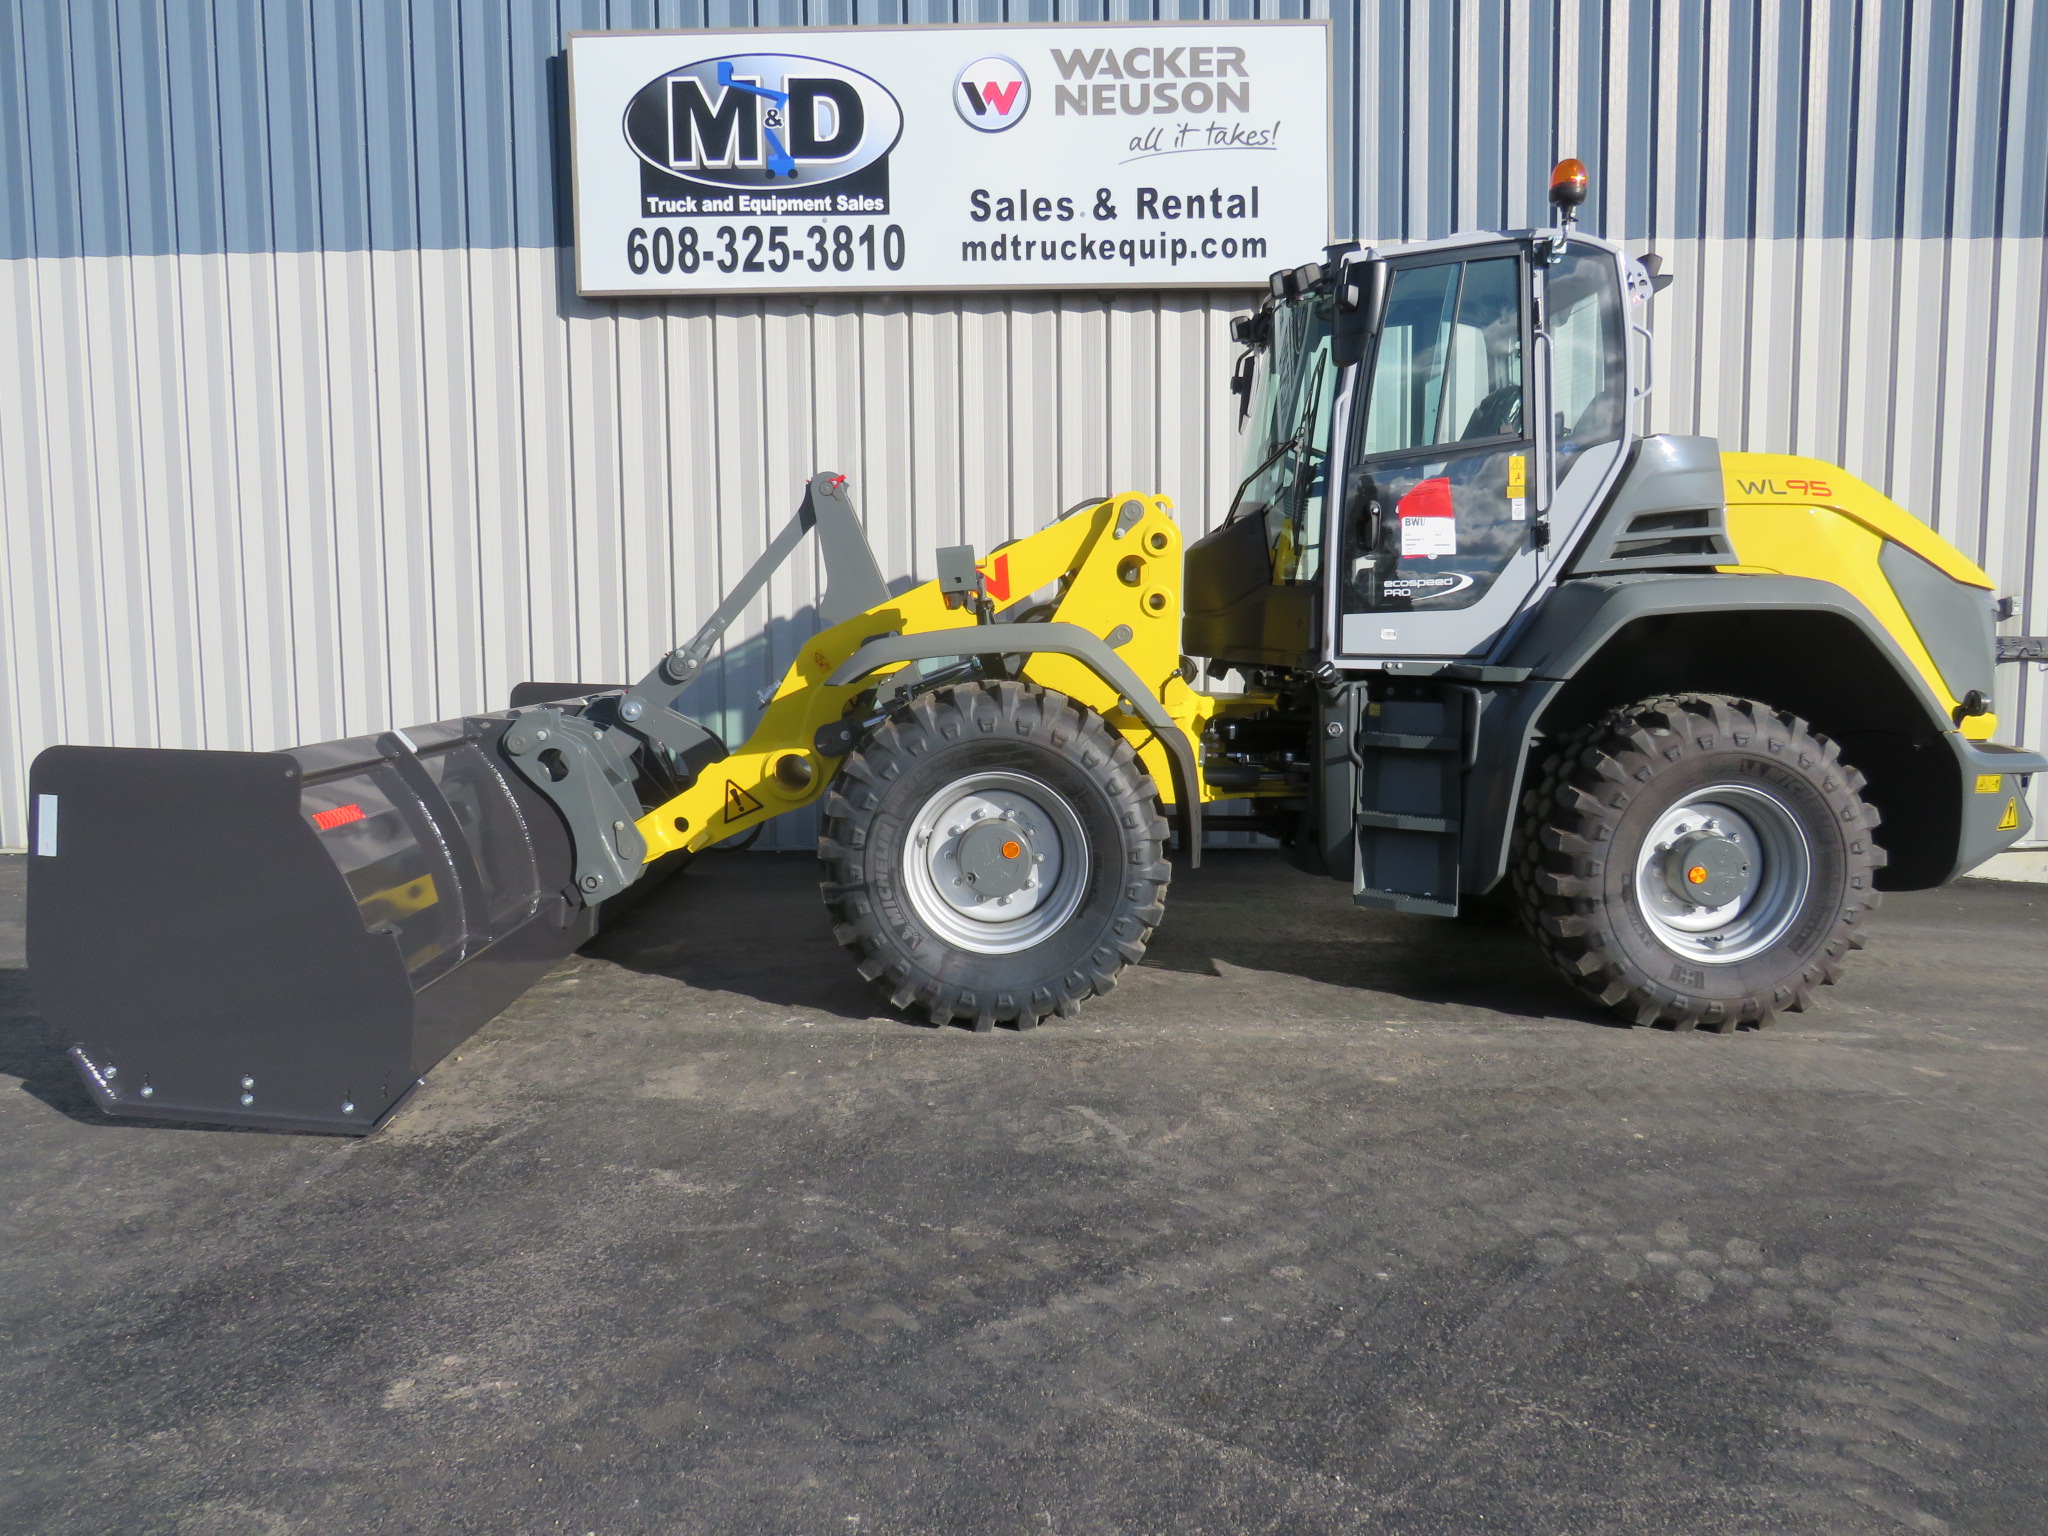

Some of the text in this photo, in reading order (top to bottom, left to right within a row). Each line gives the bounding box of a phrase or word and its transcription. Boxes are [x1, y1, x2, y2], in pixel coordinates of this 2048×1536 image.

[1050, 46, 1250, 80] WACKER
[1054, 81, 1250, 116] NEUSON
[1129, 120, 1281, 152] all it takes!
[646, 194, 885, 215] Truck and Equipment Sales
[970, 186, 1259, 222] Sales & Rental
[627, 223, 906, 275] 608-325-3810
[961, 231, 1268, 266] mdtruckequip.com
[1383, 576, 1453, 588] ecospeed
[1383, 588, 1411, 597] PRO
